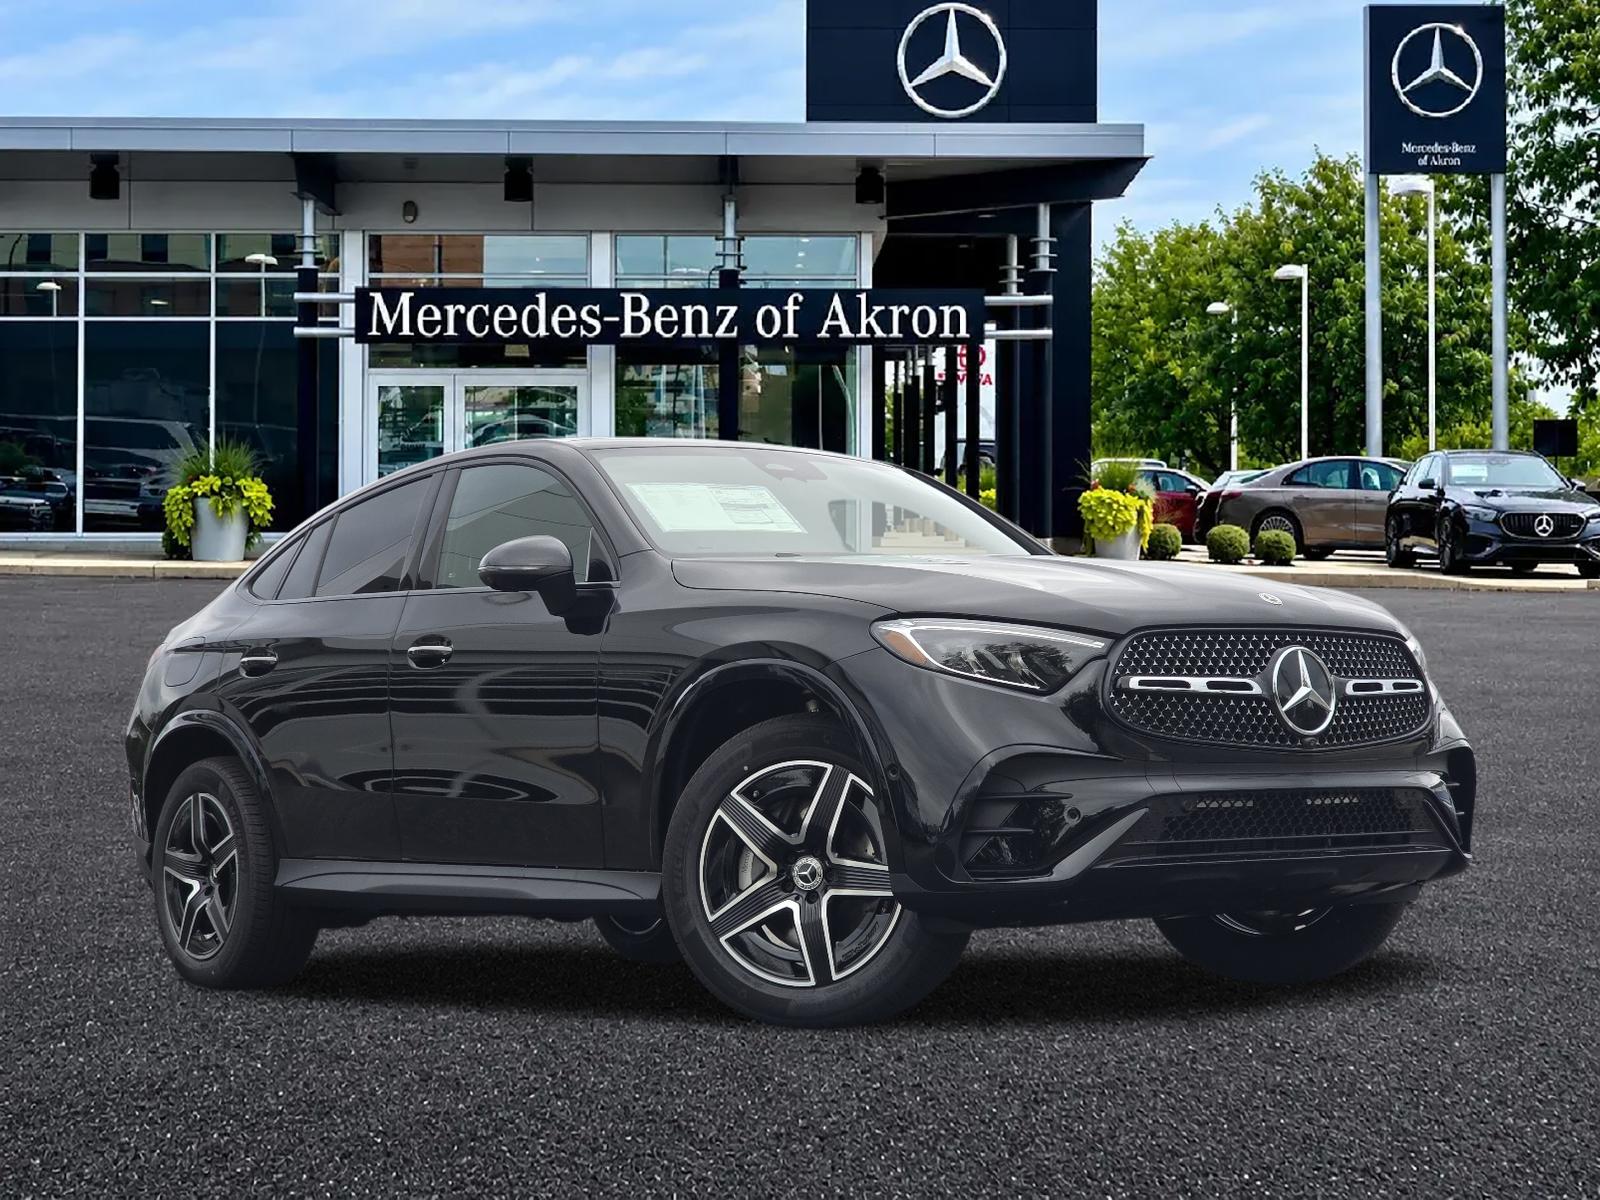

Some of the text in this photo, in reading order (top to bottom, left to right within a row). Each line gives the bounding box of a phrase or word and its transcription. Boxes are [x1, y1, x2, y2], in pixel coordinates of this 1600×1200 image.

[1401, 142, 1476, 153] Mercedes-Benz
[1417, 154, 1461, 166] of Akron
[367, 291, 971, 339] Mercedes-Benz of Akron
